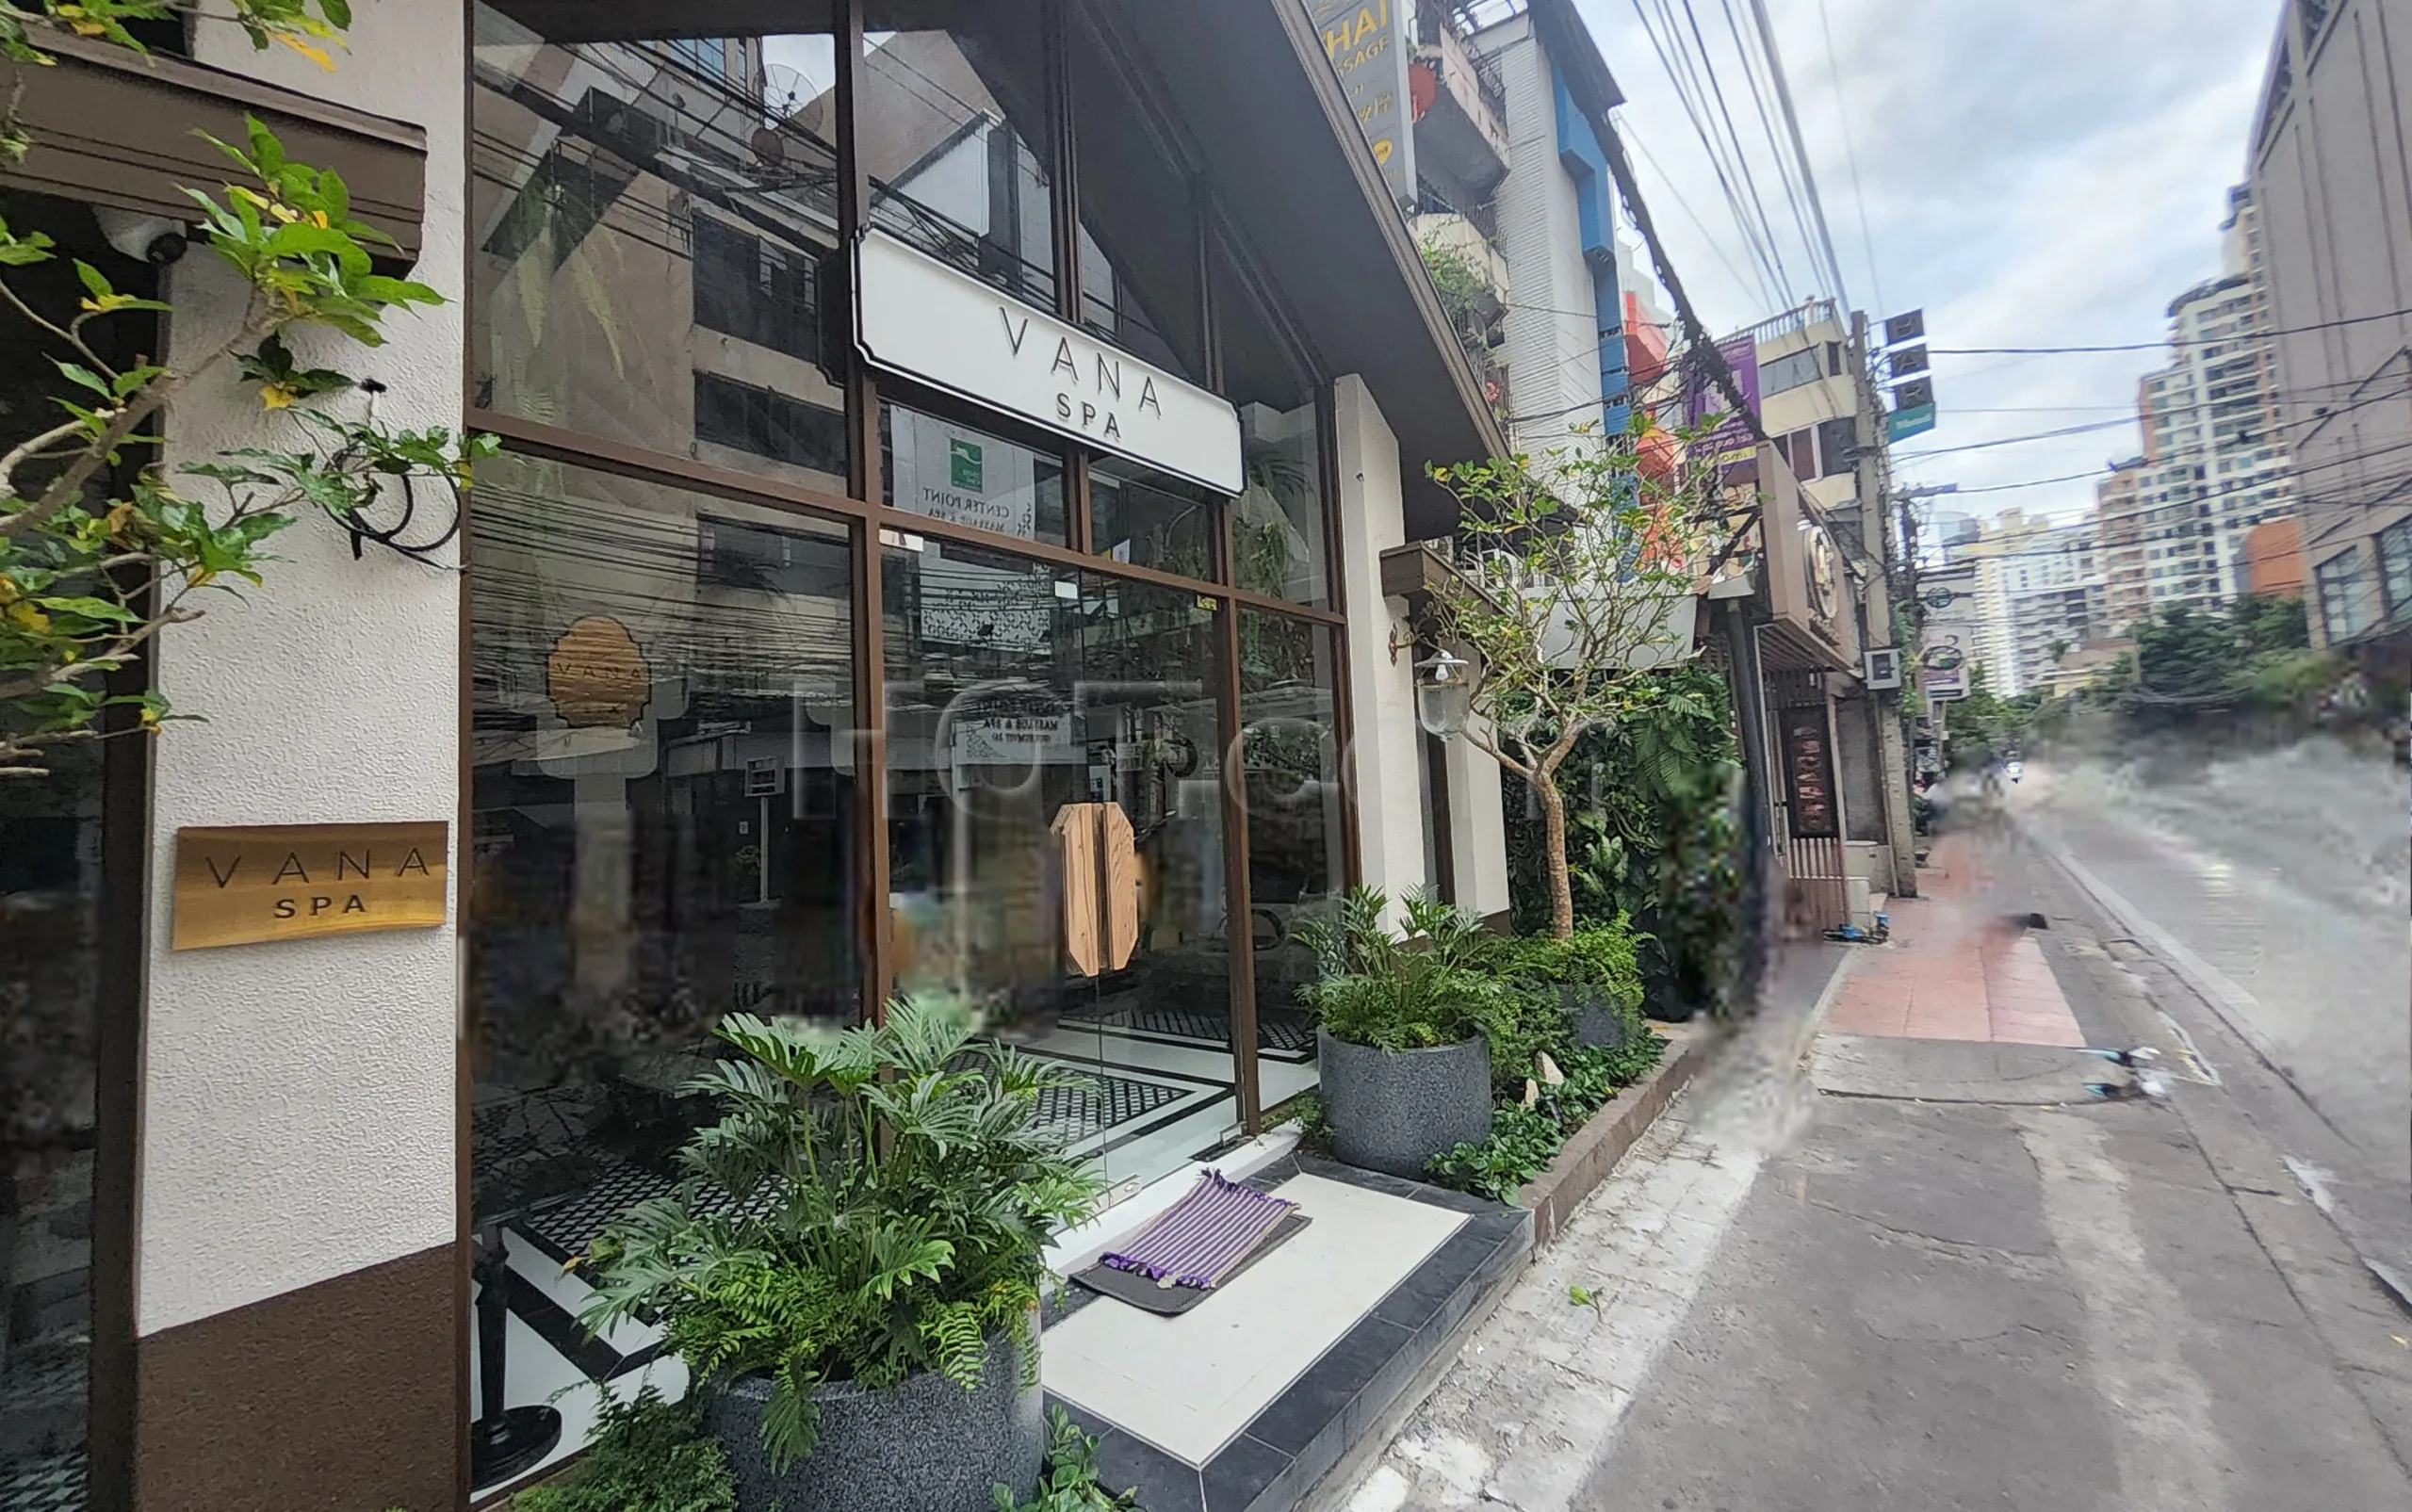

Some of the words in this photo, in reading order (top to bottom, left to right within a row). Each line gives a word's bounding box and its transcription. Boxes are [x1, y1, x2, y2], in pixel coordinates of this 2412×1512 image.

[1322, 0, 1388, 60] HAI
[999, 306, 1162, 417] VANA
[1056, 391, 1121, 439] SPA
[555, 661, 642, 678] VANA
[205, 848, 431, 889] VANA
[273, 894, 367, 919] SPA
